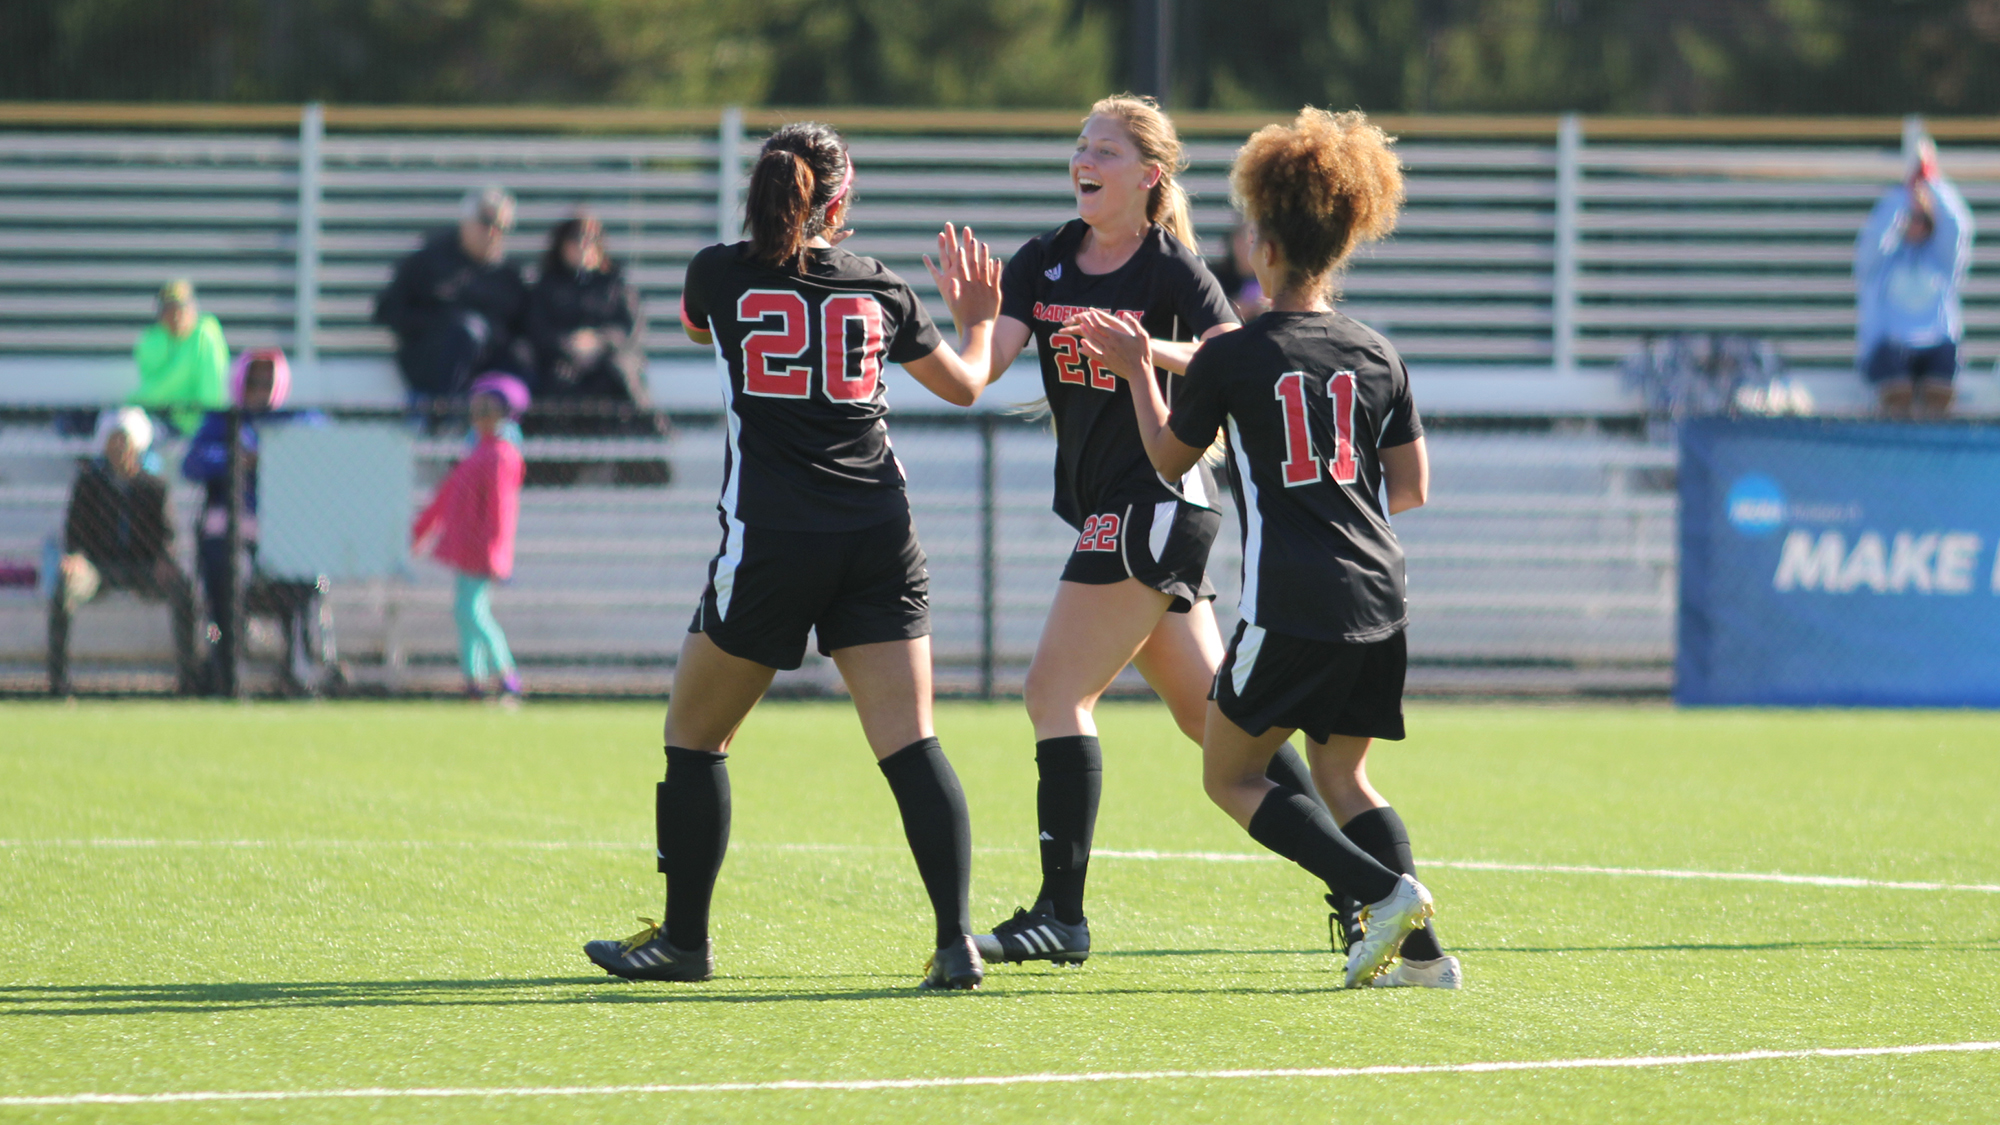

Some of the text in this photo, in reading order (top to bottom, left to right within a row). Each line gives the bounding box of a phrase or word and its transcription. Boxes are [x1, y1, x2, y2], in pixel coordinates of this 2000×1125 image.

[737, 288, 884, 404] 20
[1274, 370, 1359, 488] 11
[1076, 513, 1121, 552] 22
[1773, 529, 1983, 596] MAKE
